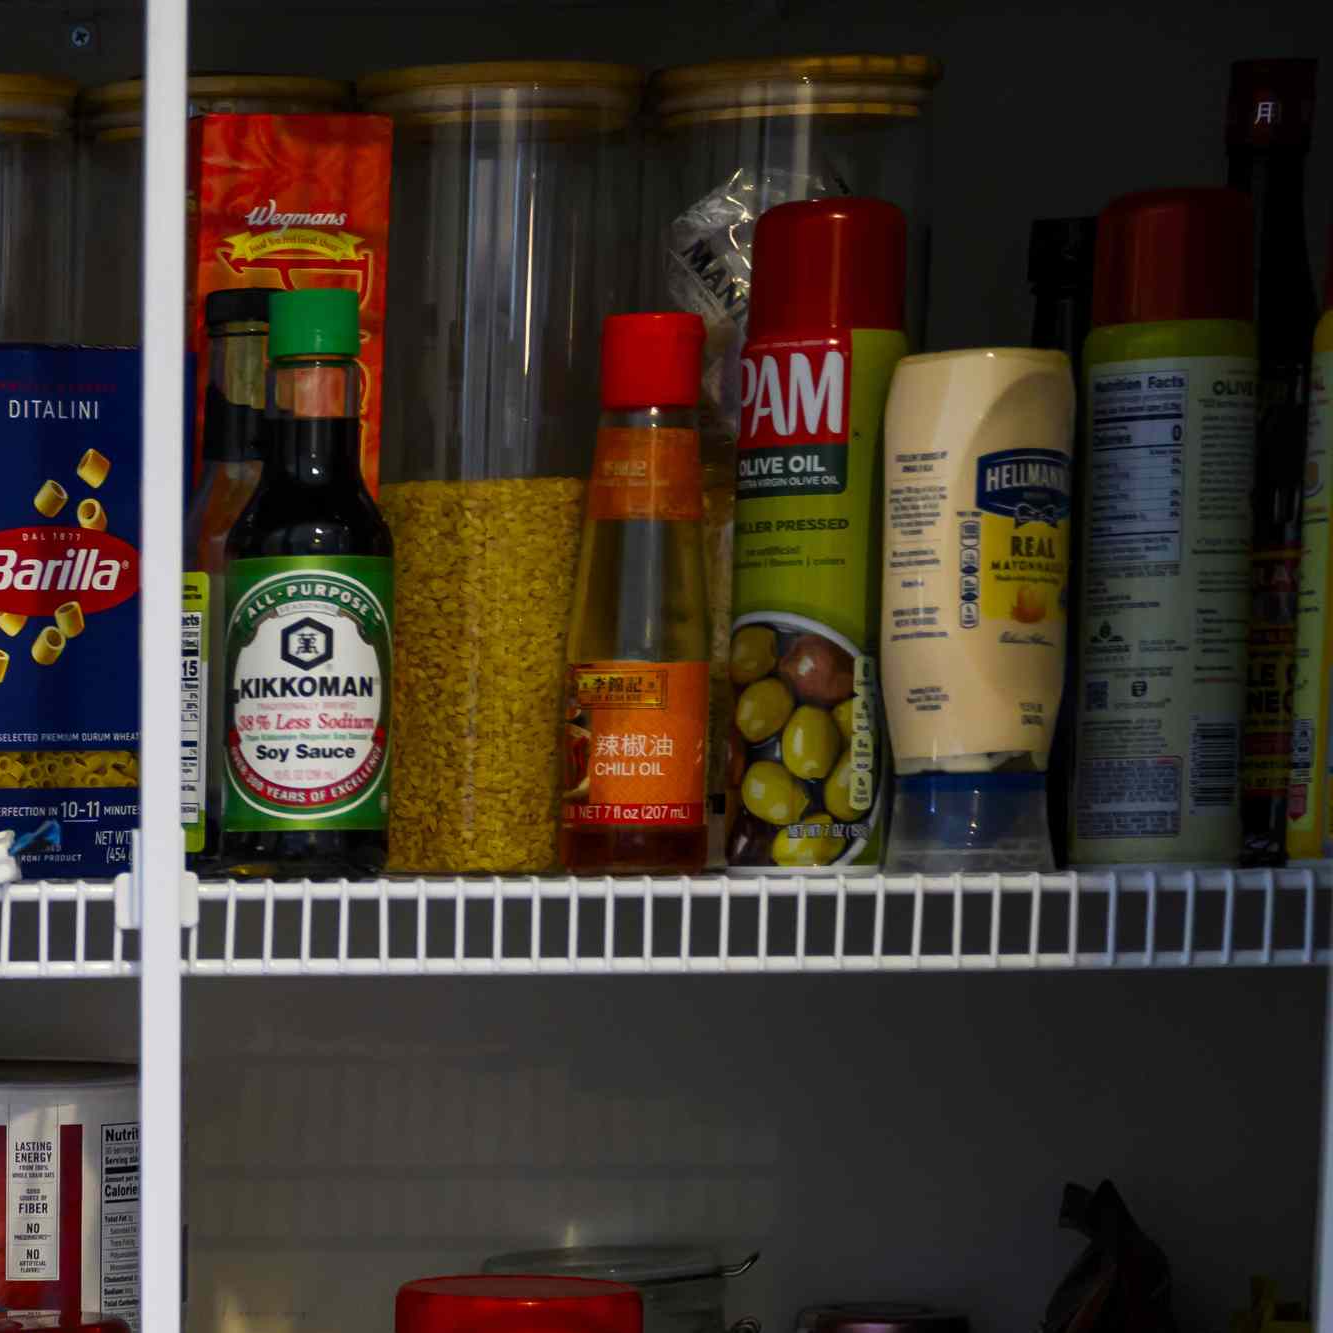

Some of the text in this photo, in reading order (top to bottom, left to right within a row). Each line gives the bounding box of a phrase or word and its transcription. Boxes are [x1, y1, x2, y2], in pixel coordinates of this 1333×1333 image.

[246, 198, 347, 229] Wegmans
[7, 399, 100, 421] DITALINI
[739, 454, 827, 475] OLIVE OIL
[775, 517, 850, 532] PRESSED
[21, 532, 46, 542] DAL
[1010, 535, 1056, 558] REAL
[240, 676, 374, 700] KIKKOMAN
[275, 712, 312, 731] Less
[318, 710, 375, 730] Sodium
[40, 731, 79, 743] PREMIUM
[81, 731, 111, 742] DURUM
[255, 743, 356, 763] Soy Sauce
[594, 733, 674, 759] 辣椒油
[594, 761, 665, 777] CHILI OIL
[60, 800, 100, 819] 10-11
[579, 804, 613, 820] NET 7
[94, 830, 114, 848] NET
[15, 1141, 52, 1152] LASTING
[15, 1152, 53, 1164] ENERGY
[18, 1203, 49, 1214] FIBER
[26, 1222, 41, 1234] NO
[26, 1248, 41, 1260] NO
